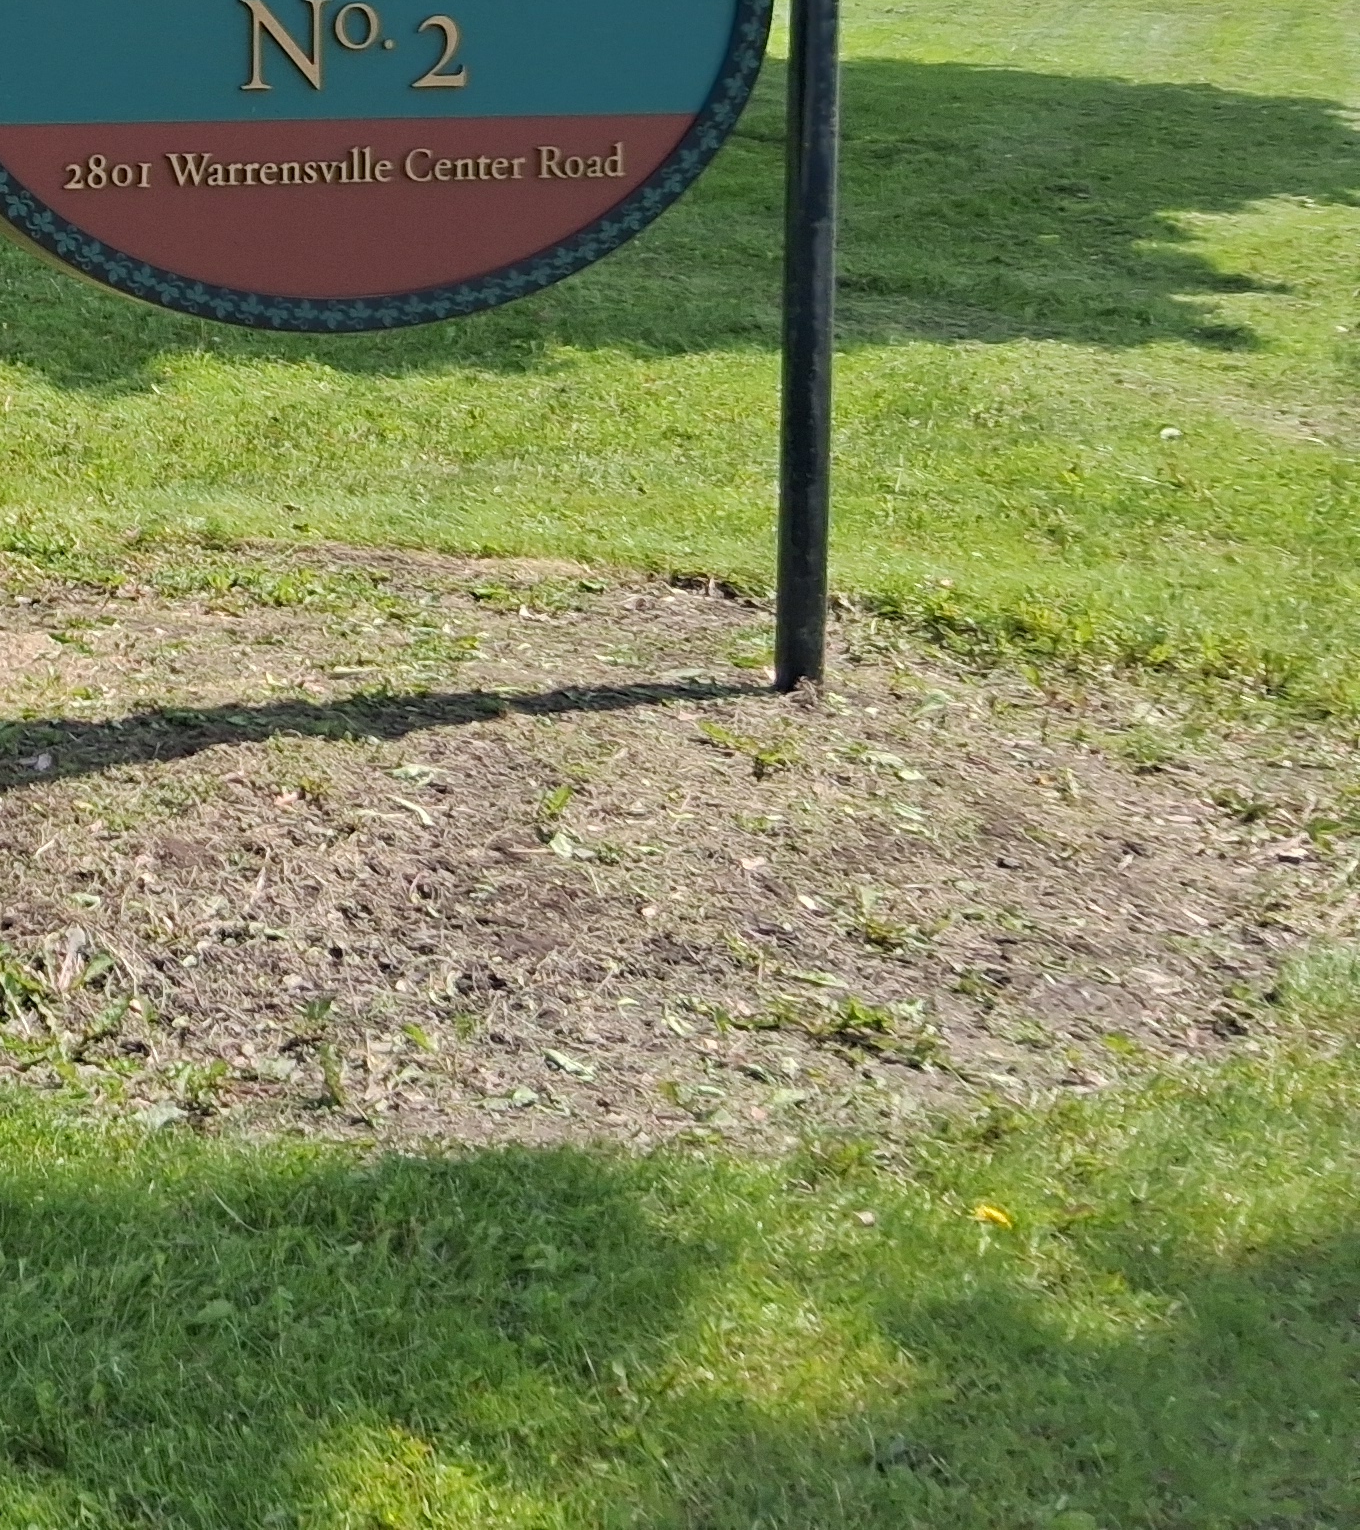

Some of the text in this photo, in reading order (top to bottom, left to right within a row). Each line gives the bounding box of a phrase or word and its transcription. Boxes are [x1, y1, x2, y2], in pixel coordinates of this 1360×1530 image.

[410, 14, 468, 88] 2
[62, 141, 627, 190] 2801 Warrensville Center Road
